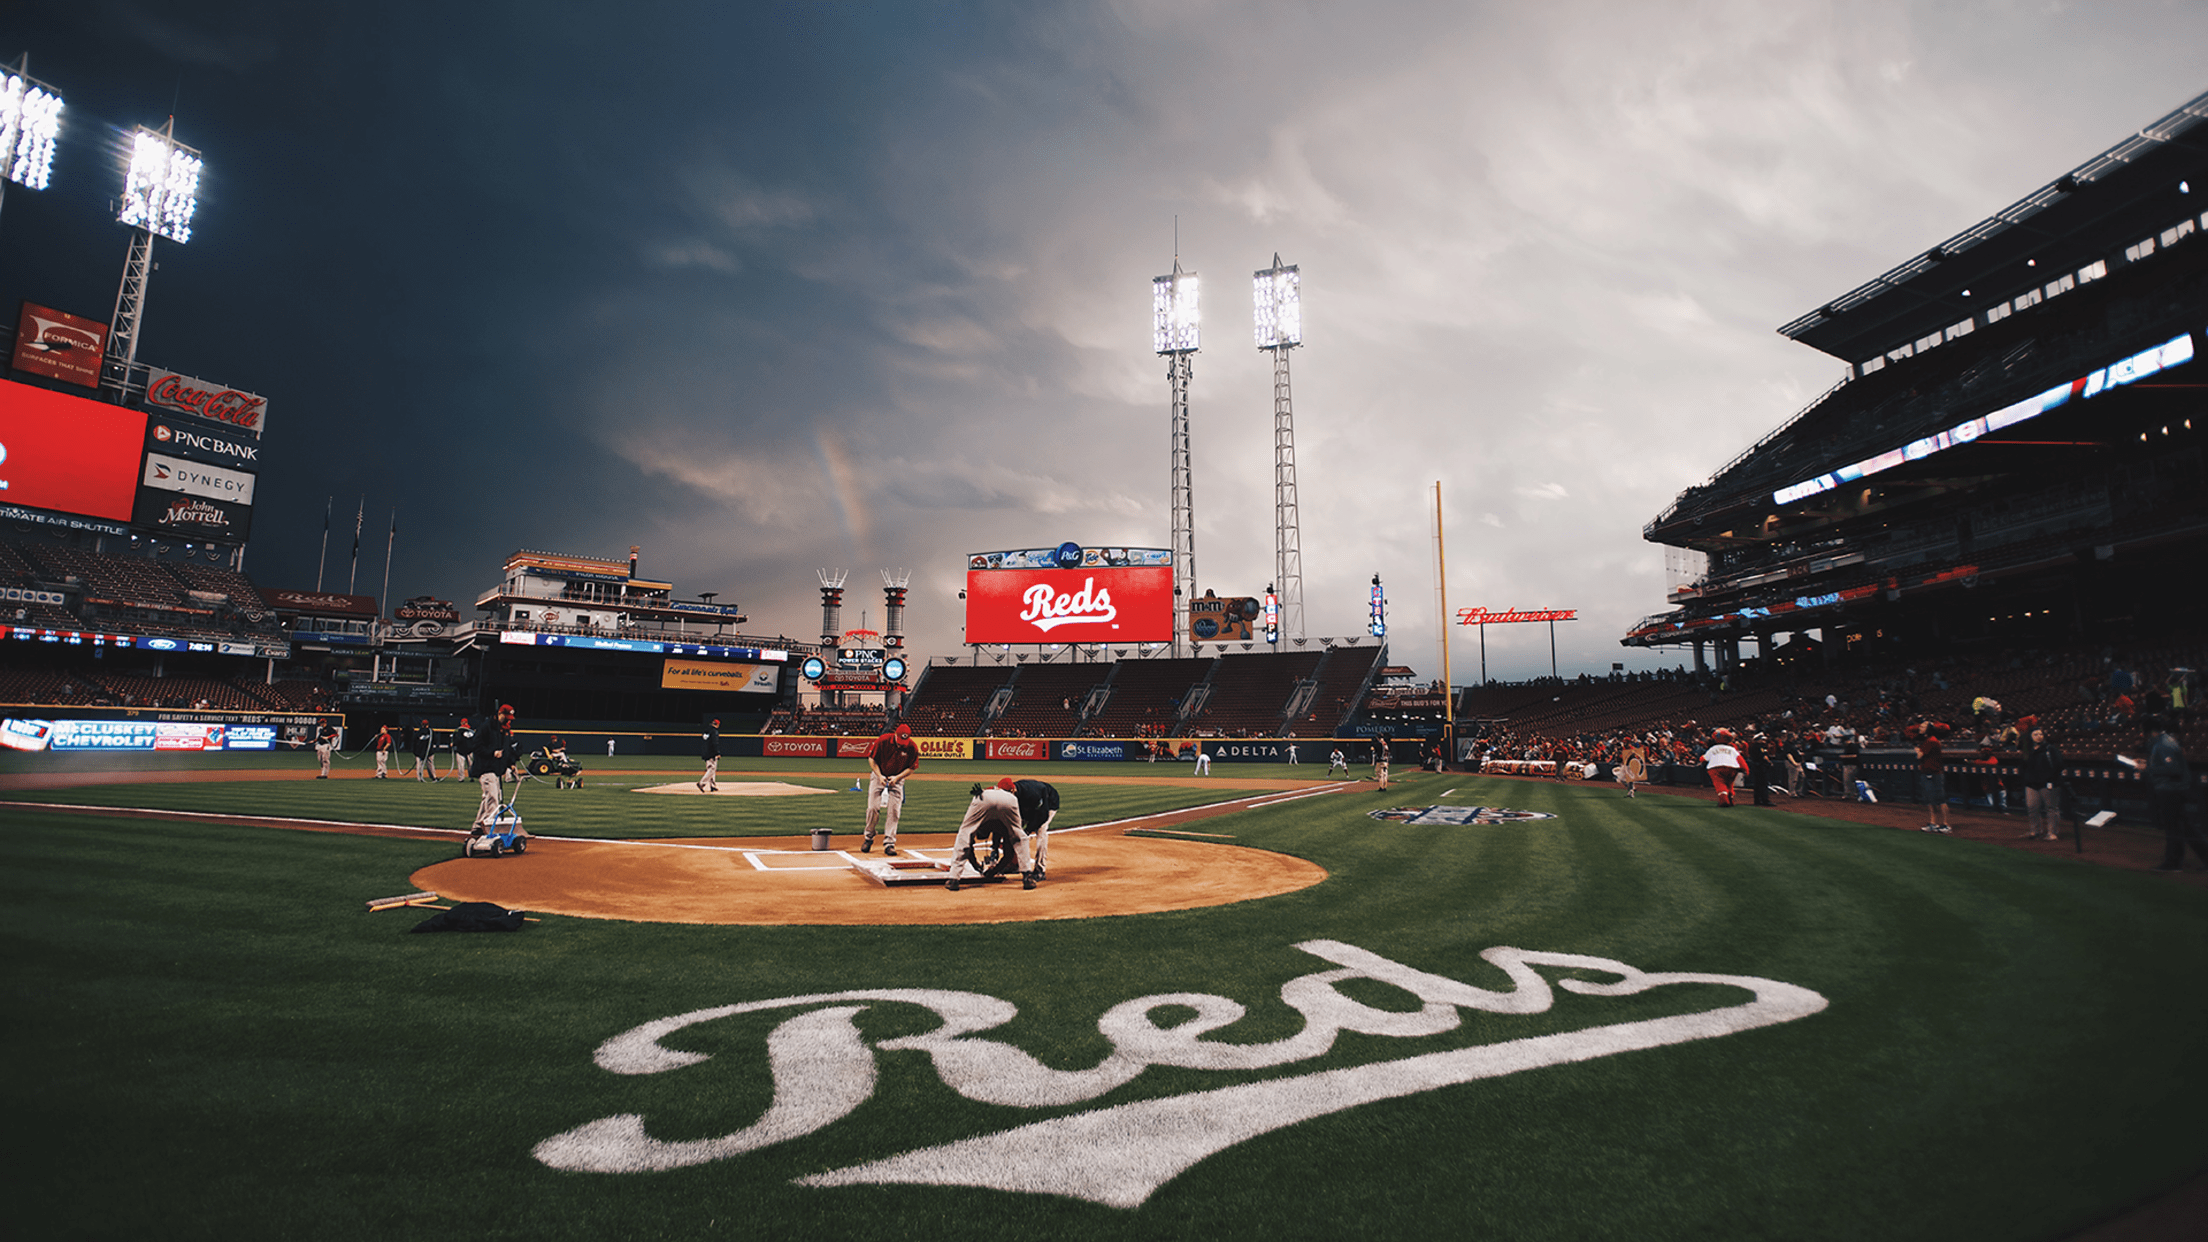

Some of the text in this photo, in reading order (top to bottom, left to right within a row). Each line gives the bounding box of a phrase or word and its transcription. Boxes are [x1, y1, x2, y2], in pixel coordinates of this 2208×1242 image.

[44, 332, 96, 352] FORMICA
[148, 375, 267, 427] Coca-Cola
[177, 470, 245, 492] DYNEGY
[187, 500, 214, 512] John
[158, 507, 230, 525] Morrell
[47, 517, 67, 526] AIR
[70, 521, 125, 536] SHUTTLE
[1061, 551, 1080, 560] P&G
[1020, 577, 1117, 633] Reds
[416, 609, 452, 619] TOYOTA
[1457, 606, 1576, 626] Budweiser
[264, 647, 288, 658] Evans
[855, 650, 878, 659] PNC
[668, 667, 681, 675] For
[691, 669, 706, 677] life's
[240, 715, 265, 723] "REDS"
[55, 722, 156, 735] McCLUSKEY
[1356, 725, 1396, 733] POMEROY
[54, 735, 155, 746] CHEVROLET
[784, 742, 823, 752] TOYOTA
[998, 742, 1036, 757] Coca-Cola
[1087, 745, 1123, 754] Elizabeth
[1231, 745, 1278, 756] DELTA
[532, 939, 1829, 1209] Reds
